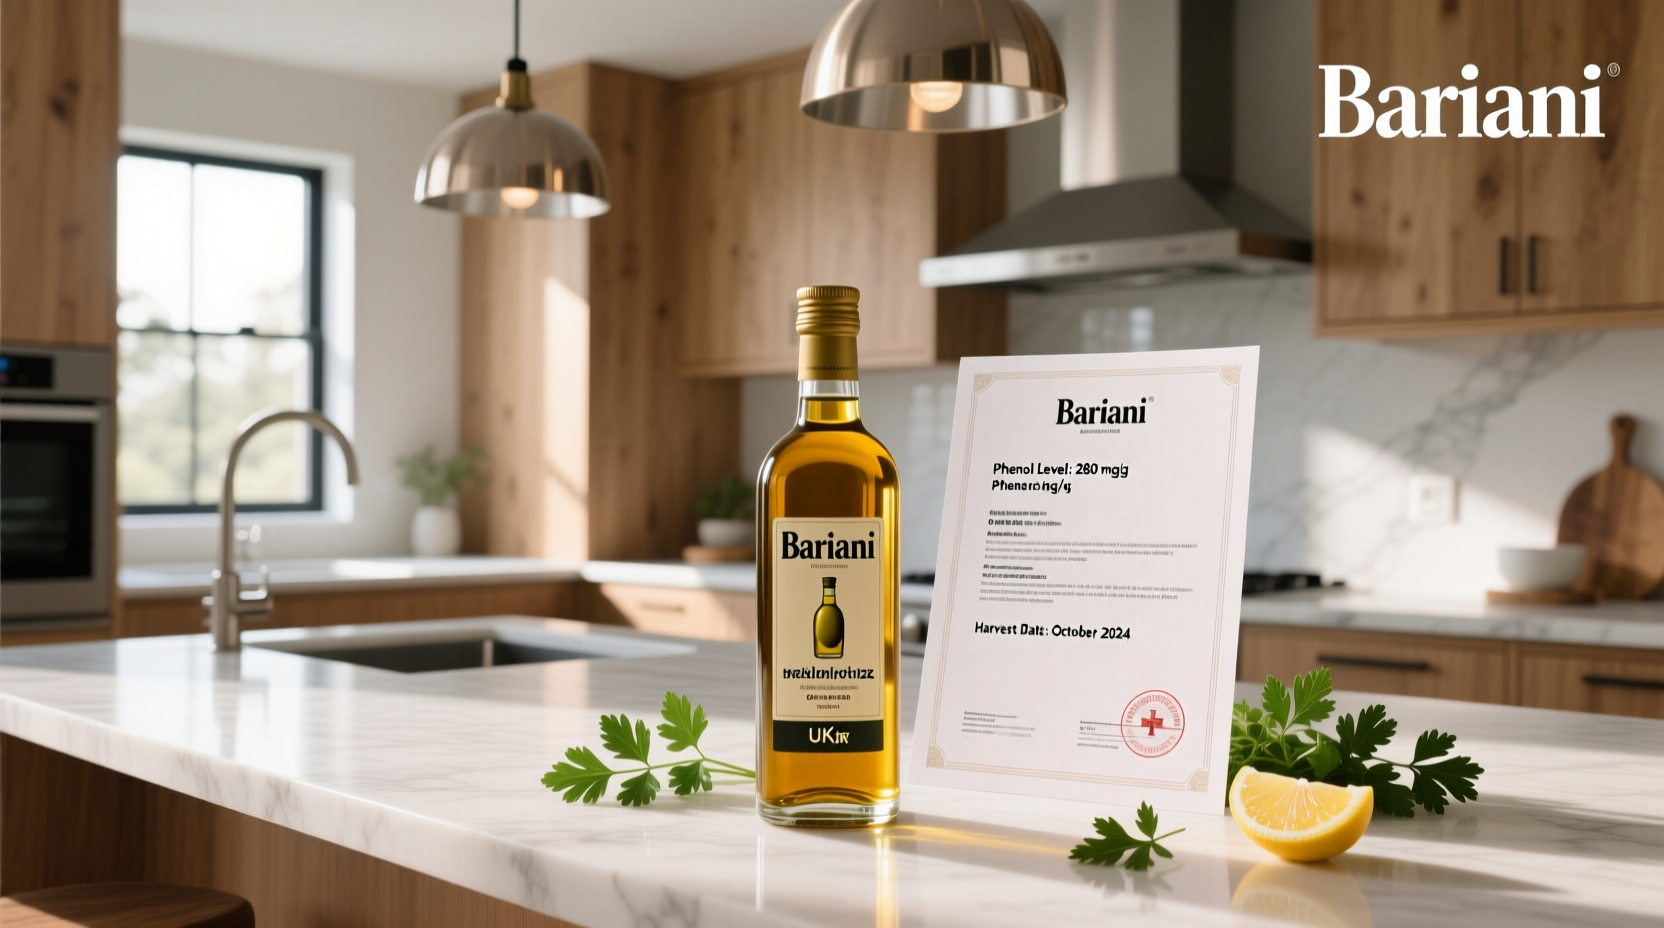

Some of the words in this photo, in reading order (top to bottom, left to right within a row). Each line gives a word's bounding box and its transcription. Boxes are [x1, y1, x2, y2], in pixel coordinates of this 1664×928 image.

[993, 462, 1034, 475] Phenol
[1037, 462, 1073, 475] Level:
[781, 530, 876, 560] Bariani
[974, 621, 1017, 636] Harvest
[1051, 624, 1097, 639] October
[1100, 626, 1131, 640] 2024
